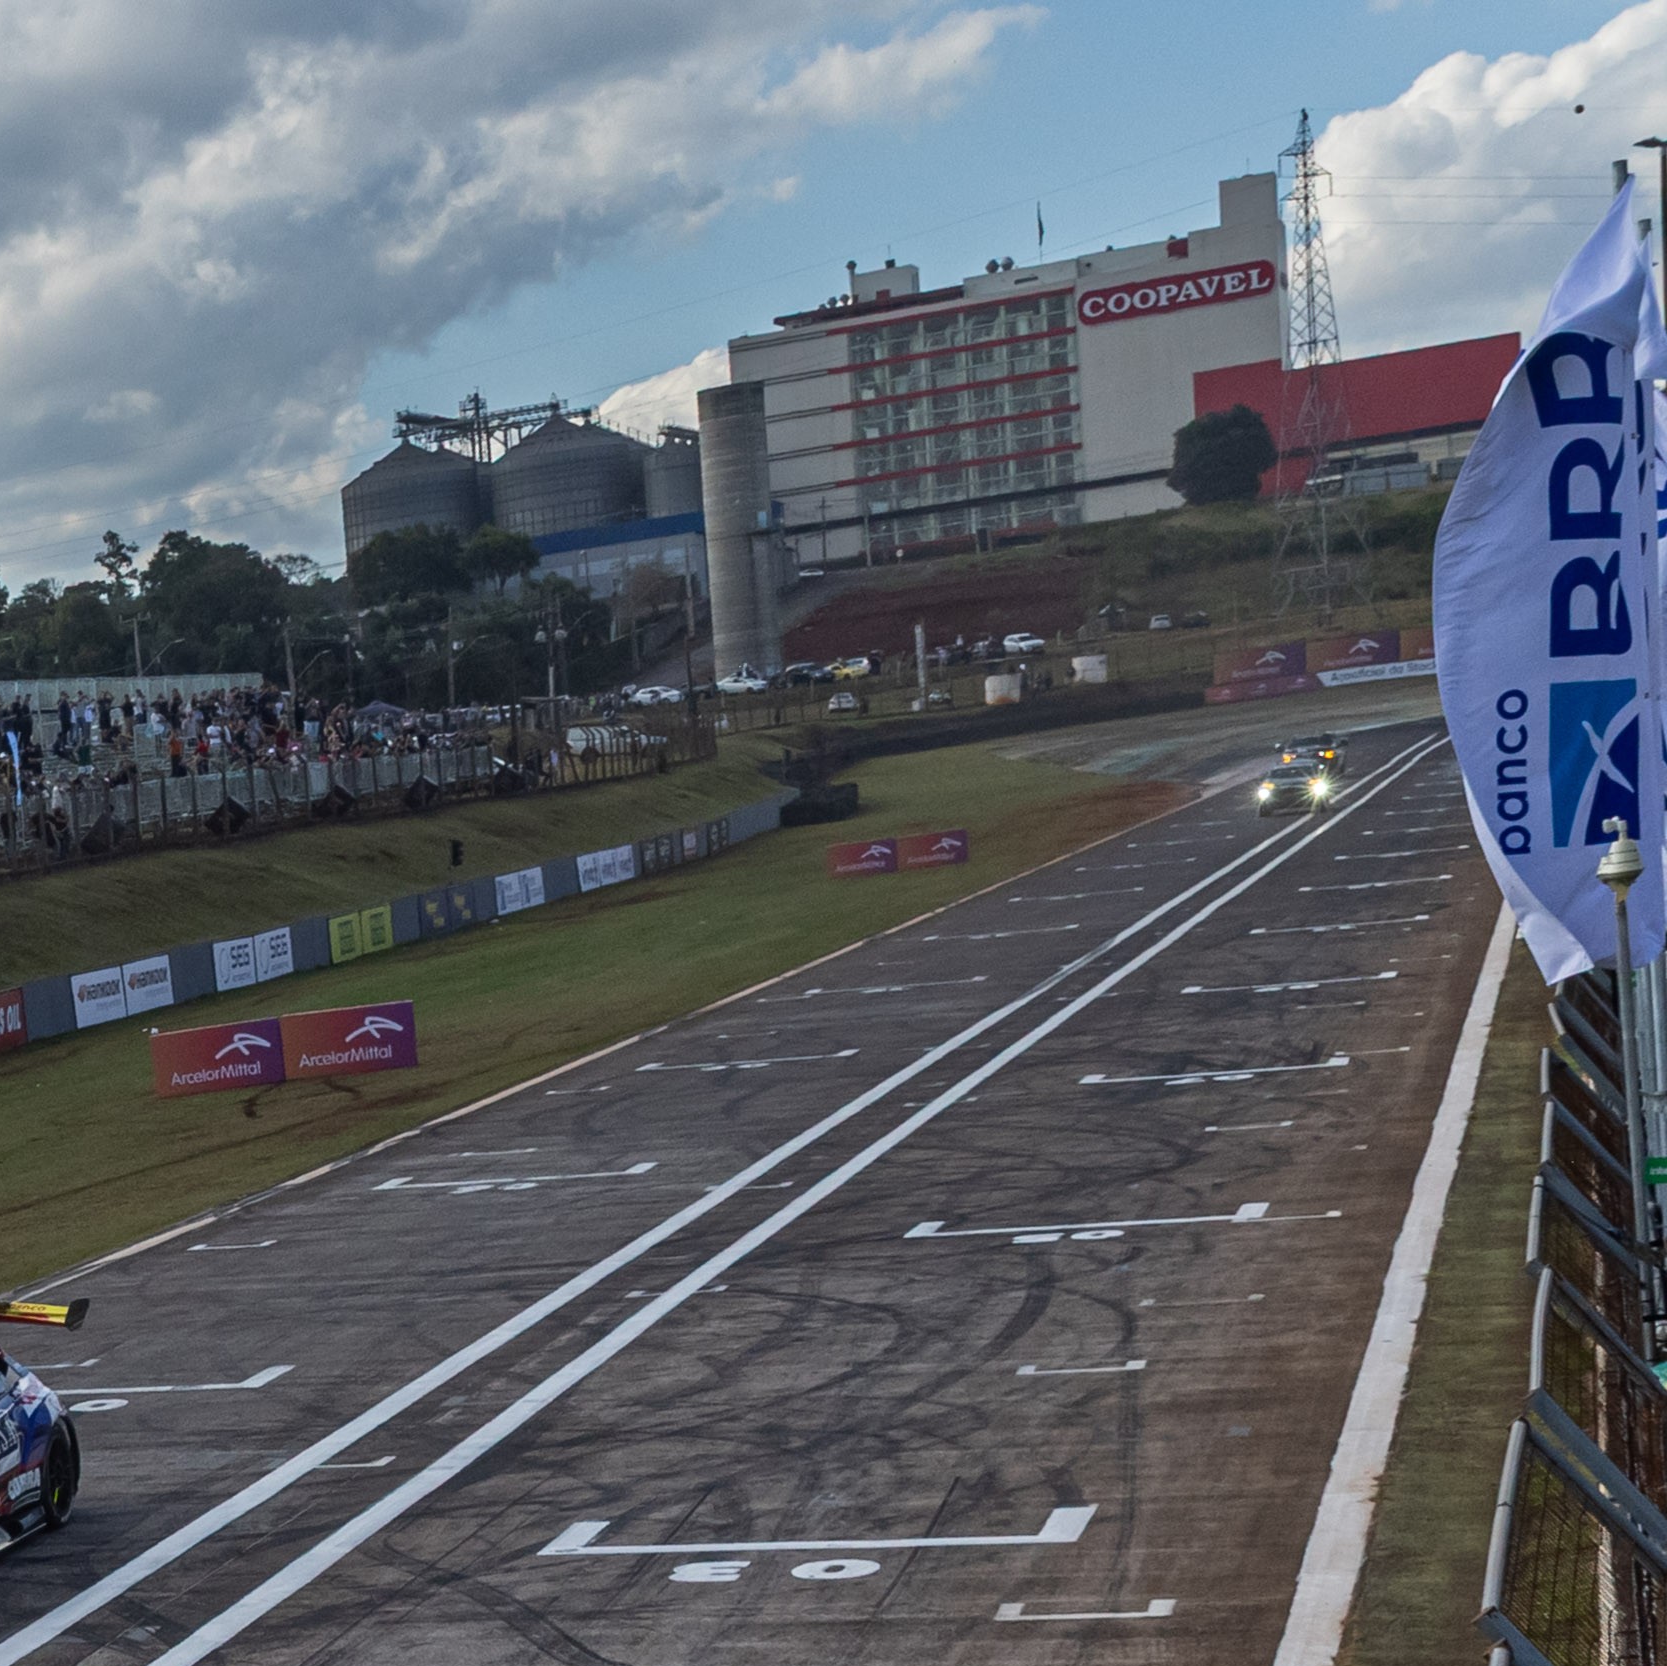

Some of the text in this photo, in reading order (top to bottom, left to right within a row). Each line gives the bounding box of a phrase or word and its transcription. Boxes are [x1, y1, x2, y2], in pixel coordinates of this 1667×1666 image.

[1082, 268, 1271, 318] COOPAVEL
[1496, 687, 1531, 856] banco
[6, 1002, 22, 1033] OIL
[299, 1045, 392, 1068] ArcelorMittal
[171, 1061, 261, 1086] ArcelorMittal
